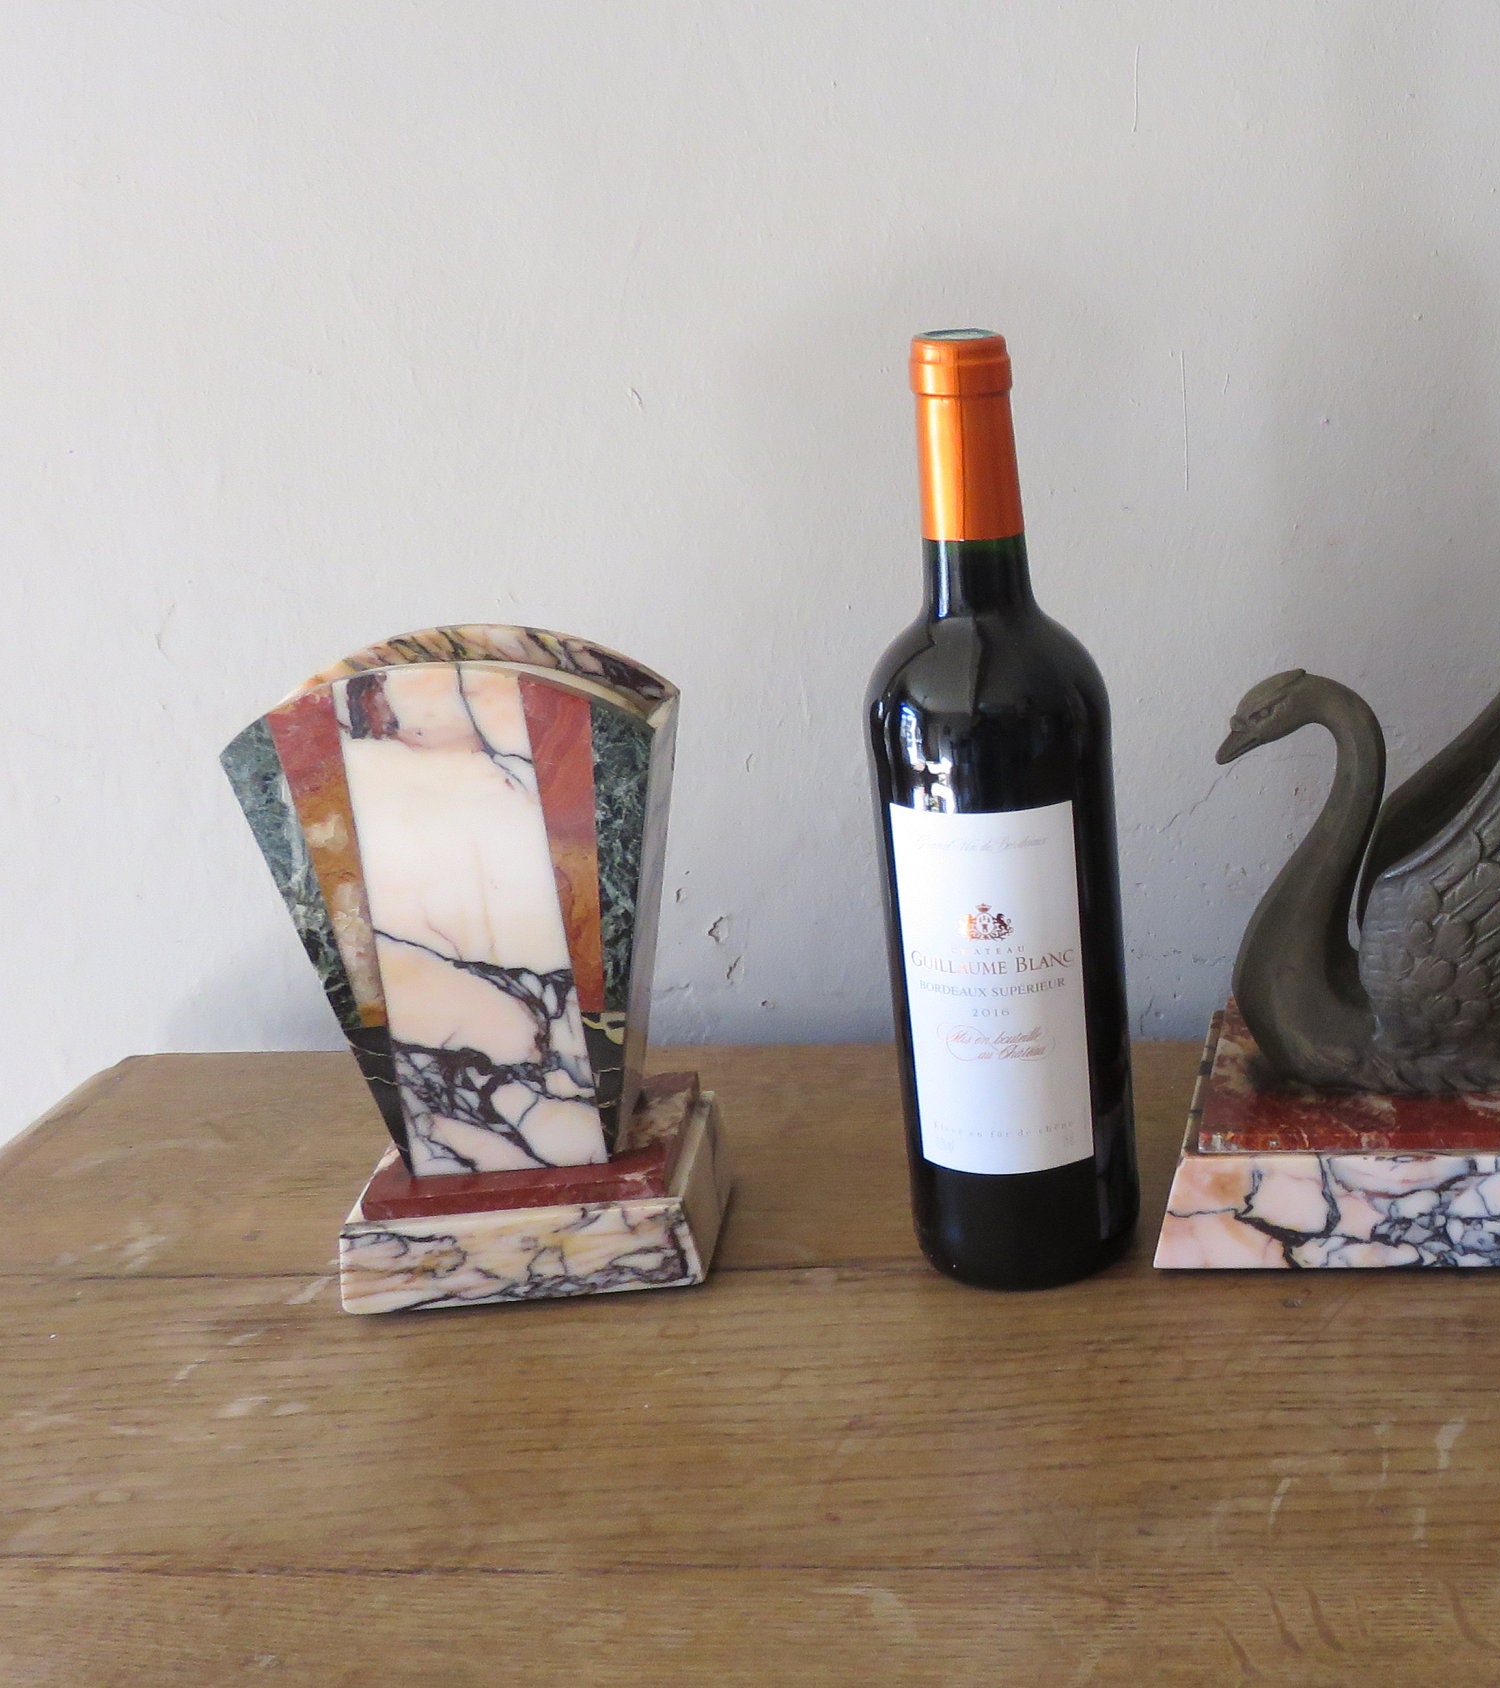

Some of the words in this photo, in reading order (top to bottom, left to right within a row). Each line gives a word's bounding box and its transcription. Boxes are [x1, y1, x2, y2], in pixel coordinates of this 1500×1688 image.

[911, 950, 1008, 975] GUILLAUME
[1016, 949, 1074, 973] BLANC
[919, 979, 988, 997] BORDEAUX
[972, 1008, 1010, 1017] 2016
